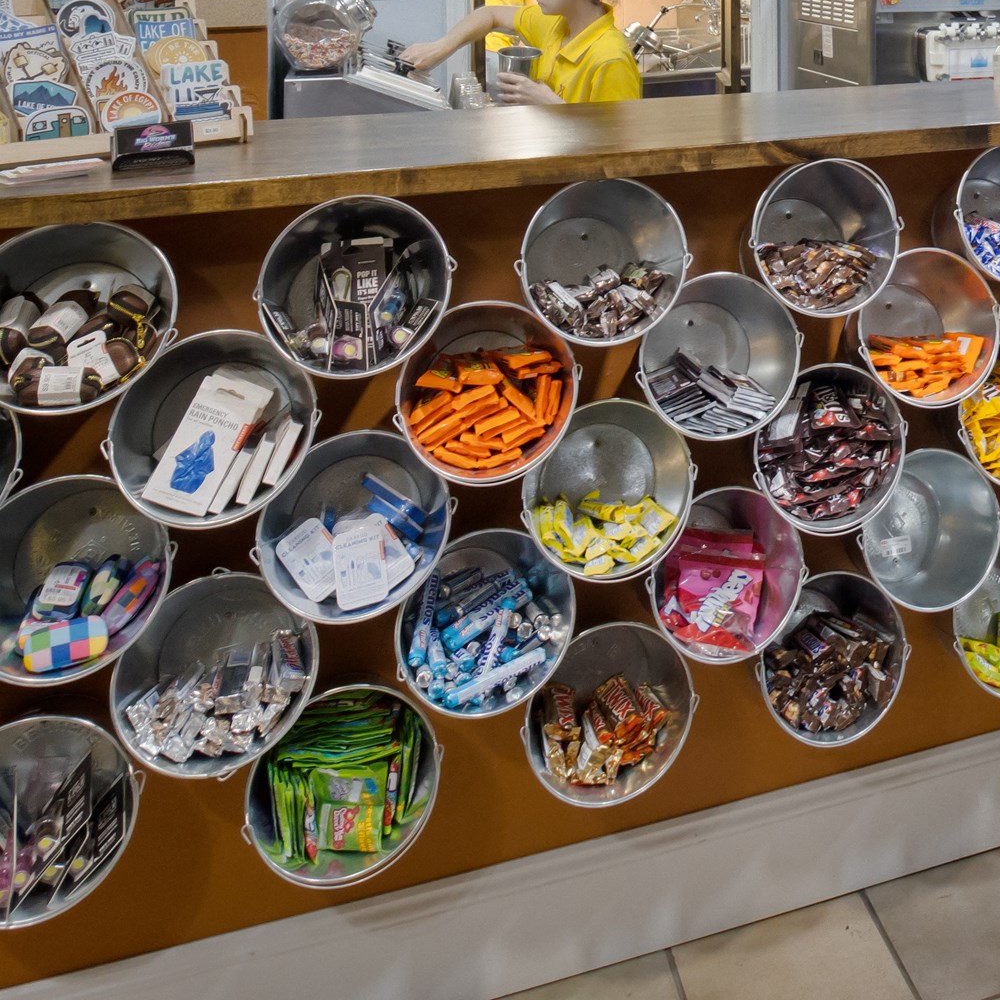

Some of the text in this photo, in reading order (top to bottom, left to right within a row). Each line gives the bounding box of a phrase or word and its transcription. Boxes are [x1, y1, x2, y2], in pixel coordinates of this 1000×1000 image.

[140, 22, 188, 39] LAKE OF
[170, 63, 223, 85] LAKE
[18, 100, 36, 108] LAKE
[110, 94, 154, 119] LAKE OF EGYPT
[357, 277, 379, 289] LIKE
[189, 409, 239, 430] RAIN PONCHO
[192, 403, 228, 418] EMERGENCY
[335, 539, 368, 550] CLEANING
[423, 574, 439, 626] mentos
[552, 688, 575, 726] TWIX
[602, 680, 635, 720] TWIX
